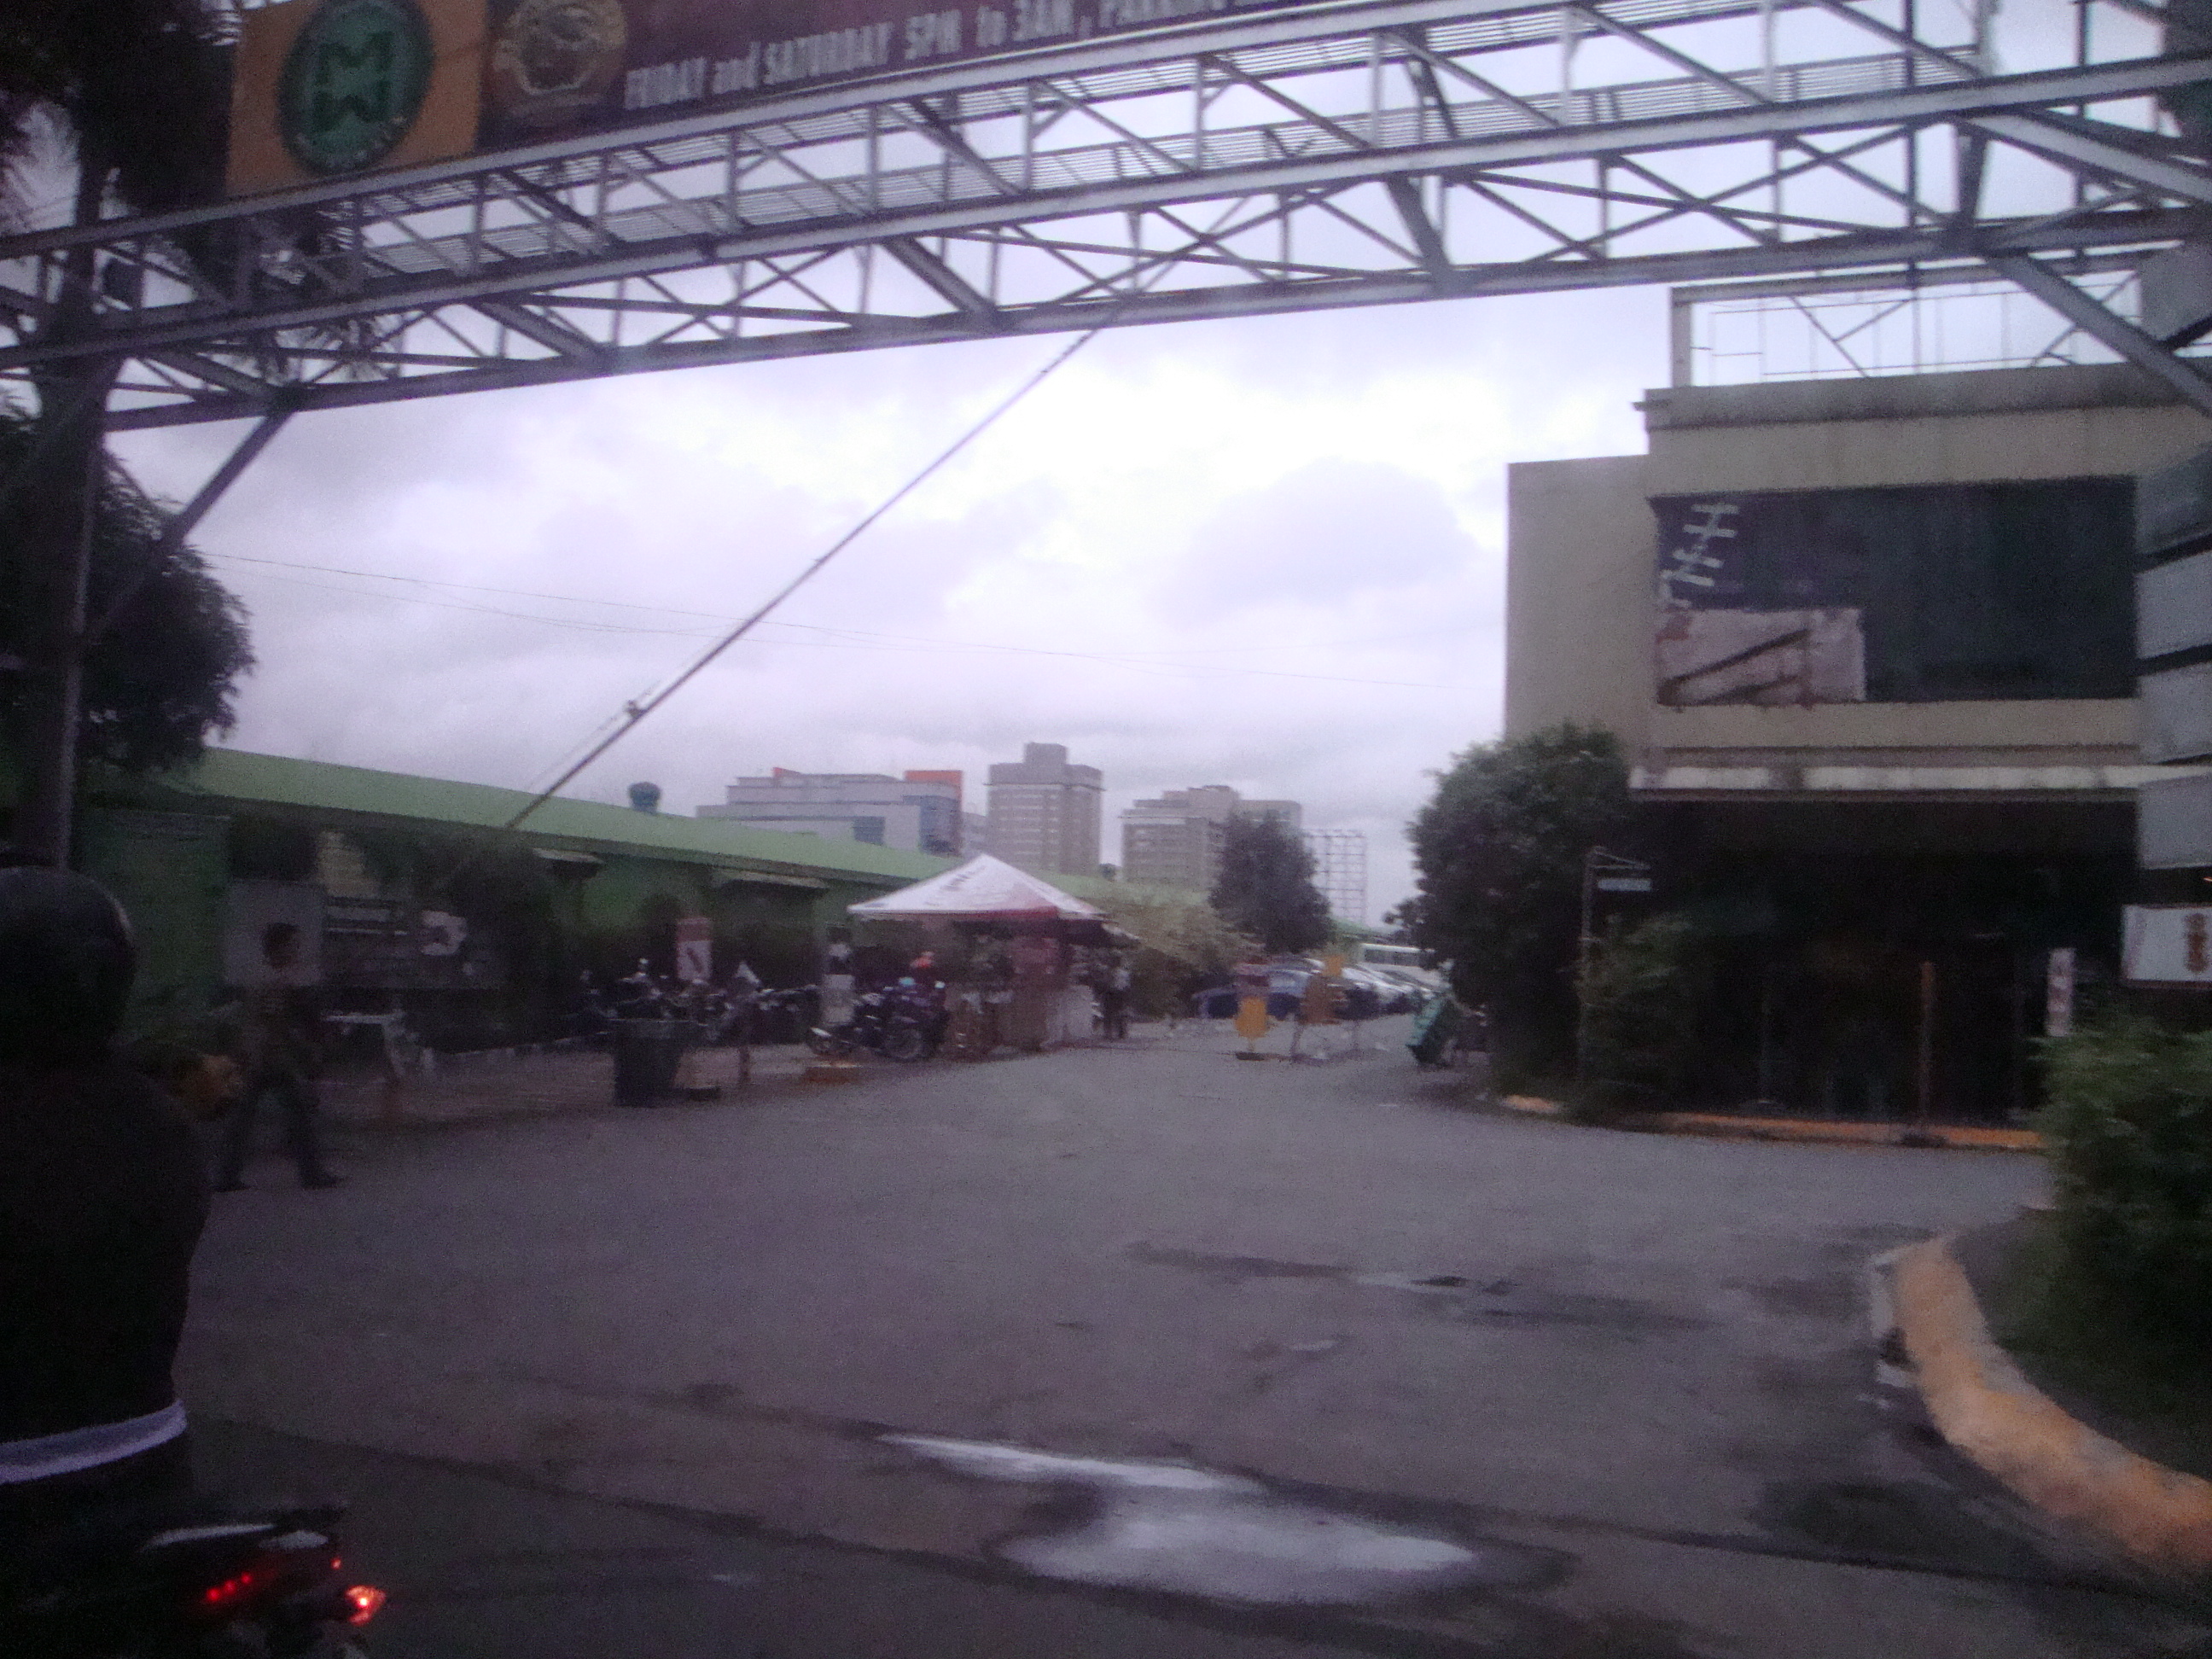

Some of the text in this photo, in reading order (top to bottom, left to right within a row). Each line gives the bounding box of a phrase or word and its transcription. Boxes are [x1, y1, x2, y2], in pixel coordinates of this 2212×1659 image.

[713, 42, 760, 94] and
[765, 22, 893, 84] SATURDAY
[976, 6, 1007, 47] to
